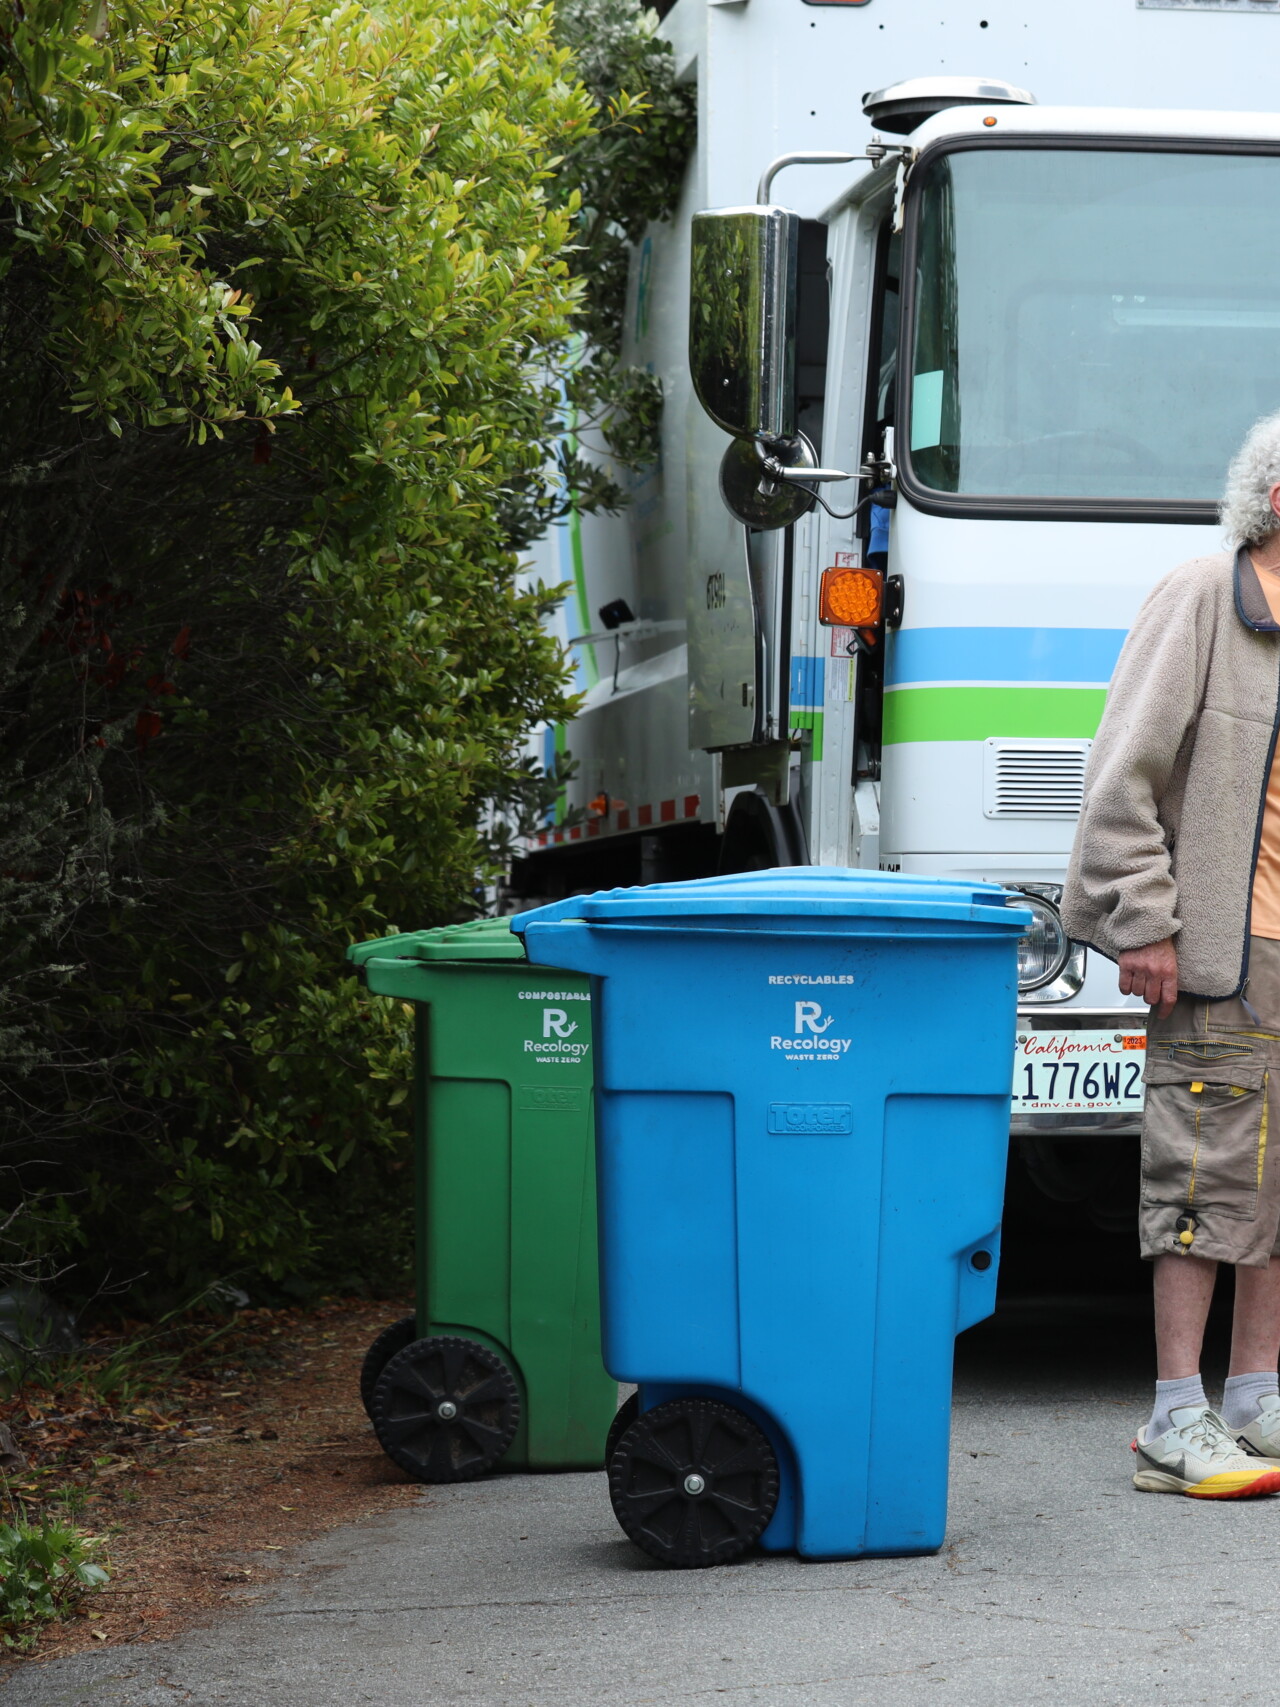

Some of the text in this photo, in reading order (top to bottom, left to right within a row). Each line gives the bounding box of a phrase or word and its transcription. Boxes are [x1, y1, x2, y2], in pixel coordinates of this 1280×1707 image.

[768, 975, 854, 985] RECYCLABLES
[543, 1008, 578, 1038] R
[795, 1001, 834, 1034] R
[524, 1040, 589, 1056] Recology
[770, 1035, 852, 1053] Recology
[1024, 1036, 1122, 1060] California
[560, 1056, 581, 1064] ZERO
[1012, 1062, 1141, 1100] 1776W2
[1031, 1101, 1113, 1109] dmv.ca.gov
[771, 1104, 852, 1131] Toter
